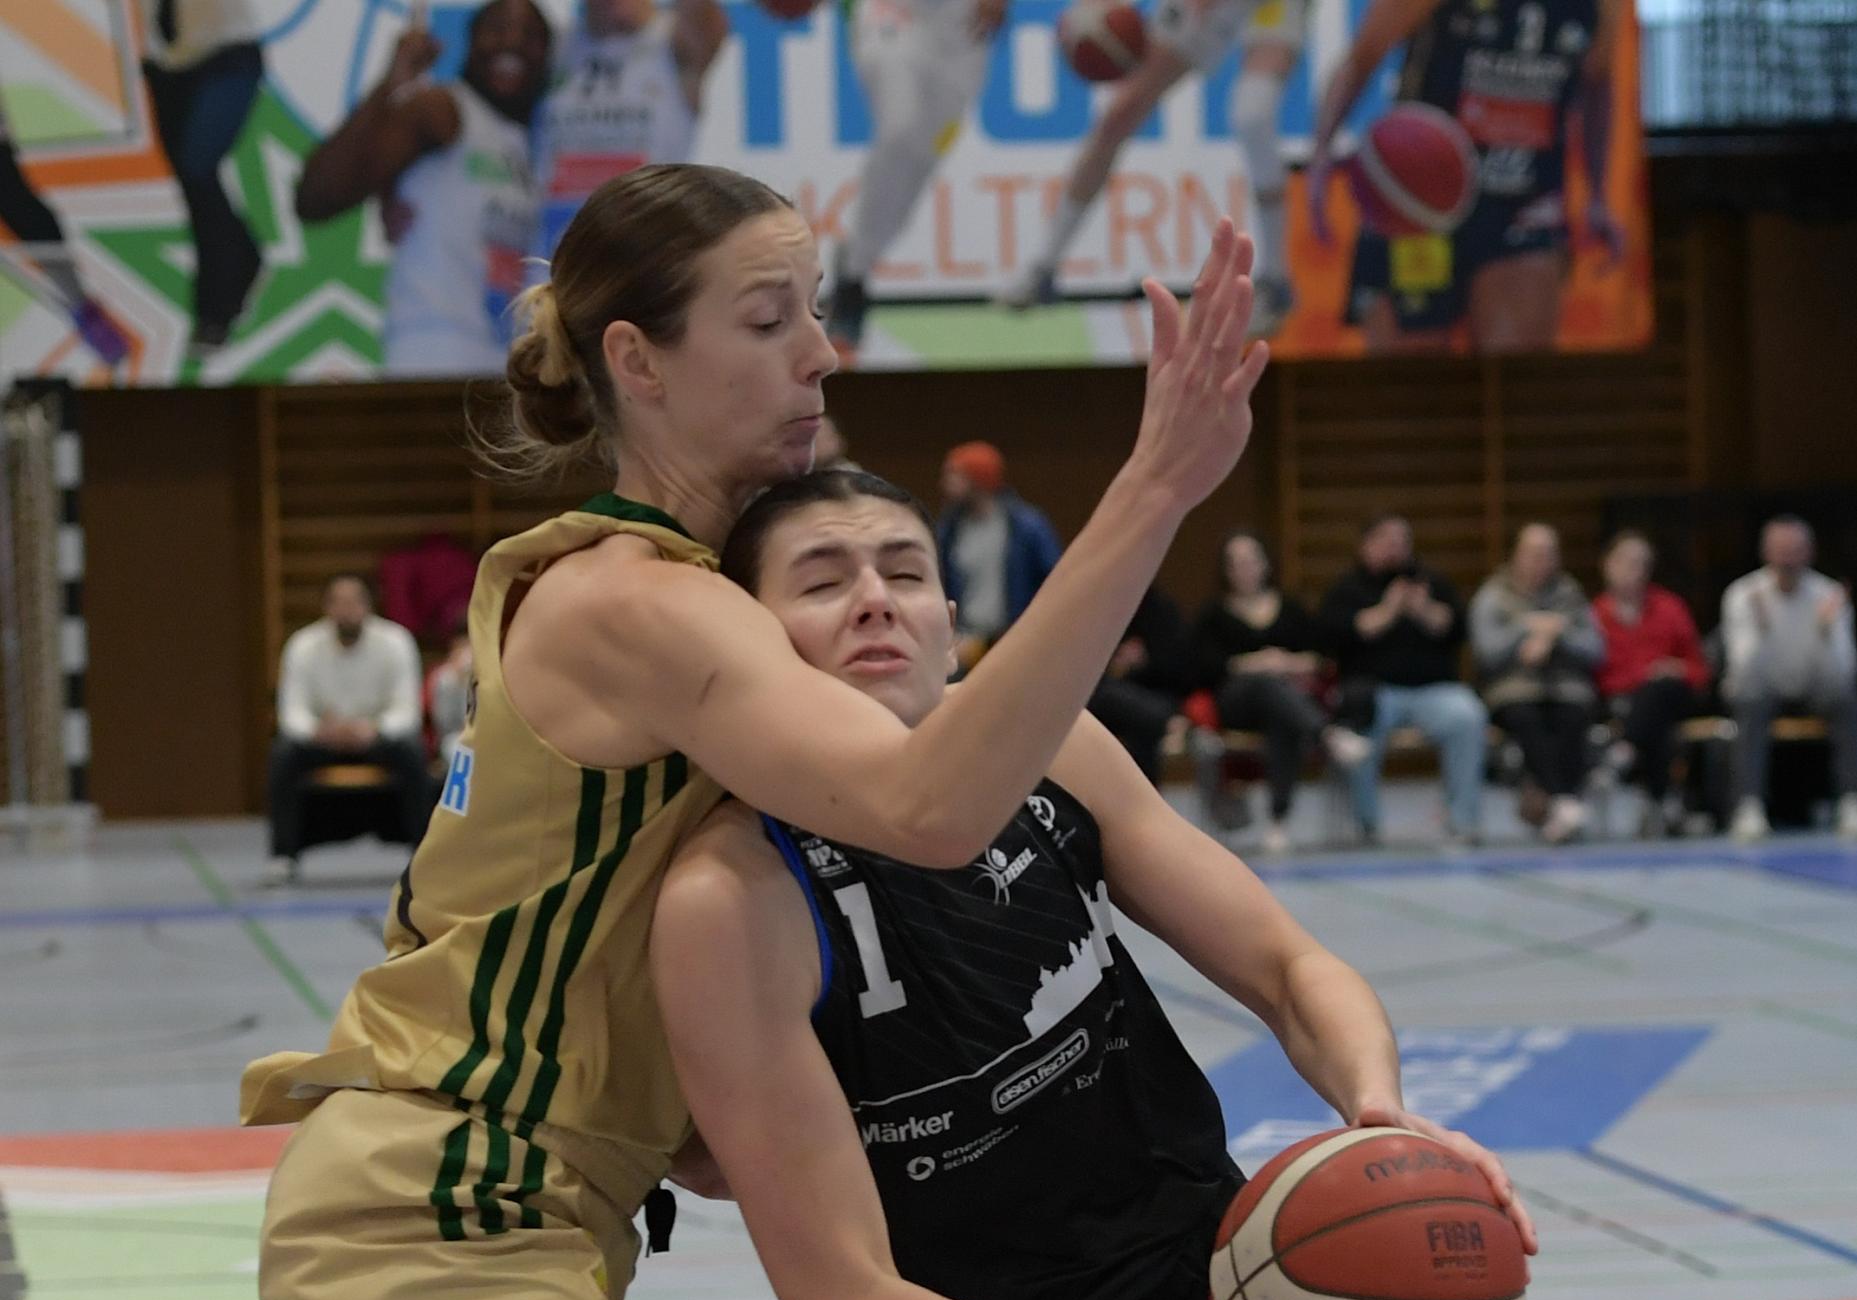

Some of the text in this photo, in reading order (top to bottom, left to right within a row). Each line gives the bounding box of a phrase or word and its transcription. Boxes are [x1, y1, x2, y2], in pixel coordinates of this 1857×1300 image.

[798, 172, 1247, 279] KLTRN
[861, 1110, 954, 1150] Märker
[1425, 1221, 1485, 1252] FIBA
